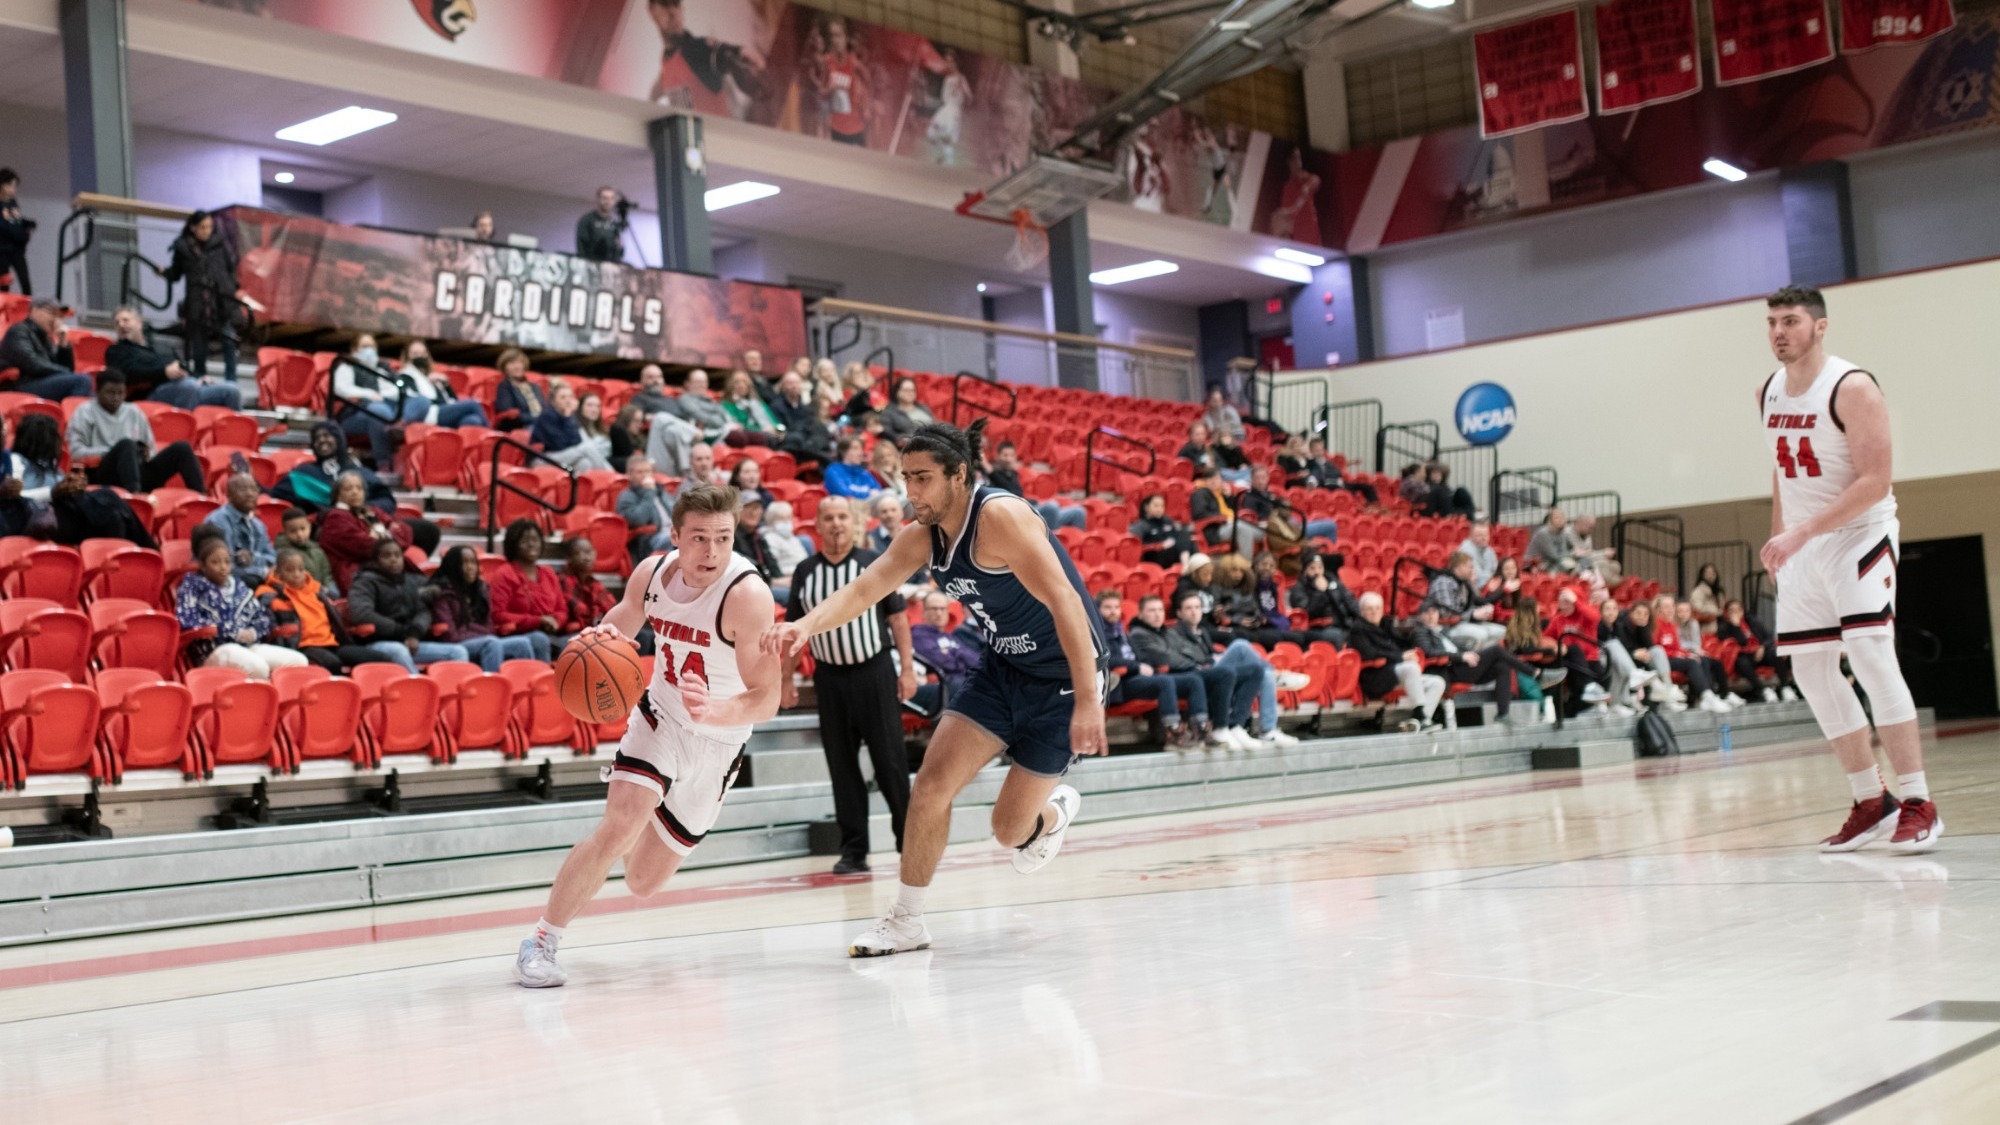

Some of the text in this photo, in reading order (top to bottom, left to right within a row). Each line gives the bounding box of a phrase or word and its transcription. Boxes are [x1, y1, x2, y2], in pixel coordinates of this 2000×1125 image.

[1872, 14, 1923, 37] 1994
[436, 272, 662, 335] CARDINALS
[1462, 406, 1517, 434] NCAA
[1777, 435, 1822, 478] 44
[661, 642, 709, 691] 14
[595, 679, 617, 711] ROCK
